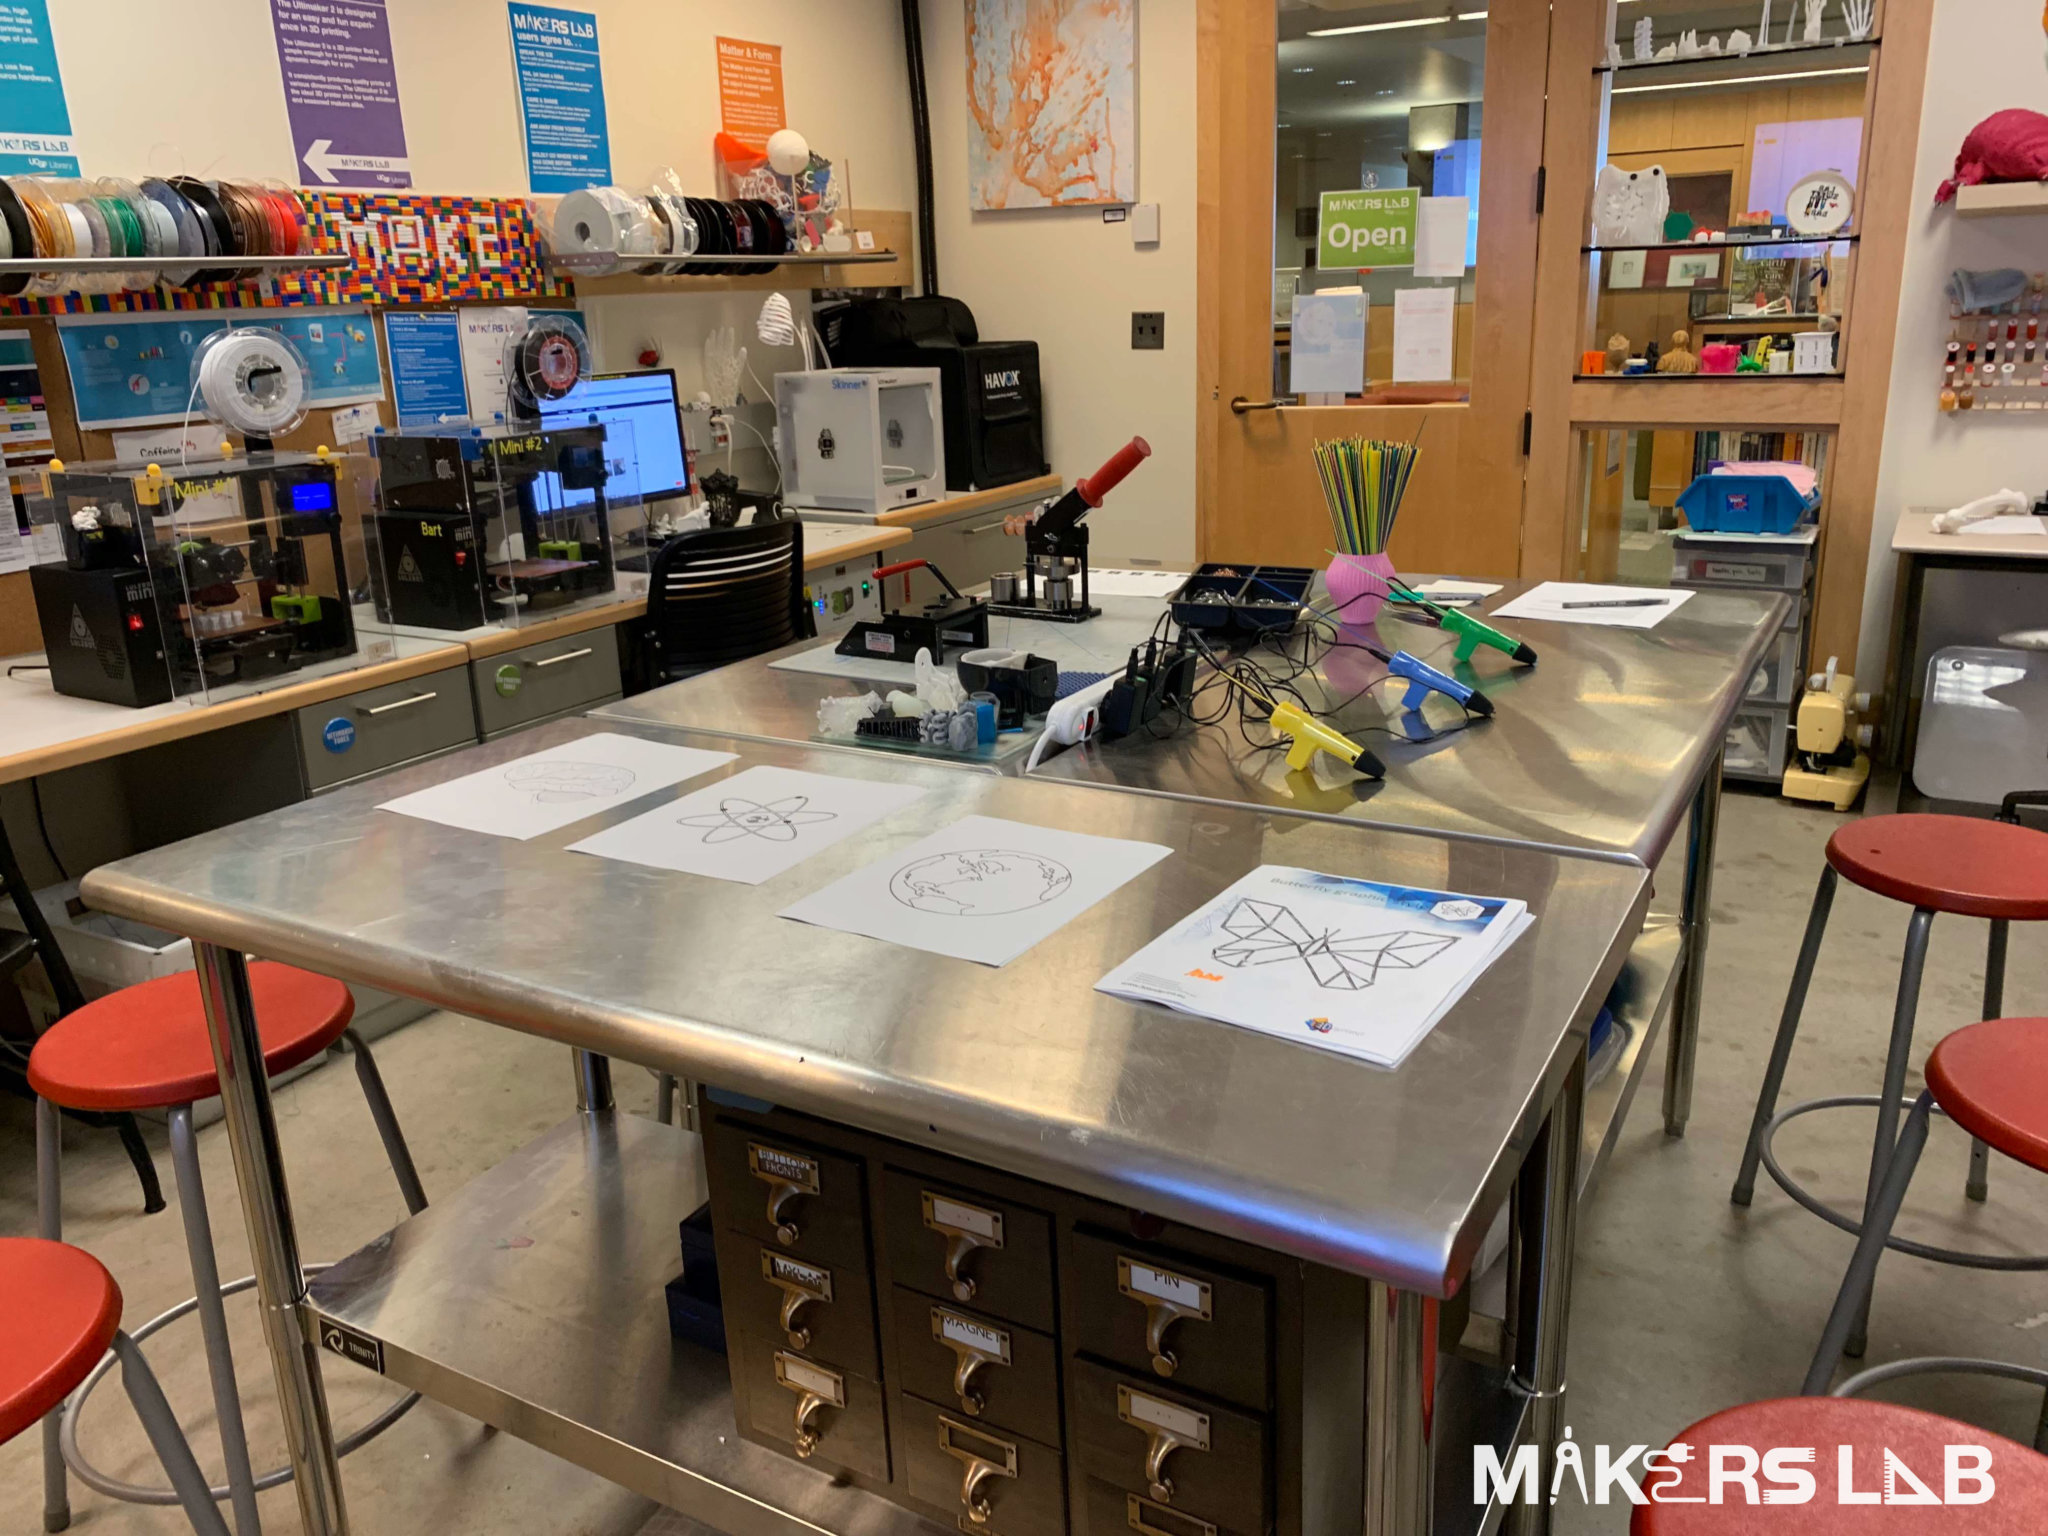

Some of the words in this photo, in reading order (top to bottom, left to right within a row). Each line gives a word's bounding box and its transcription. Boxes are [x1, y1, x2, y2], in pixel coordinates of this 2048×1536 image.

[513, 11, 570, 35] MAKERS
[570, 21, 594, 38] LAB
[516, 32, 539, 42] users
[540, 35, 562, 46] agree
[1329, 198, 1382, 212] MAKERS
[1384, 196, 1410, 210] LAB
[1328, 222, 1406, 253] Open
[832, 376, 862, 390] Skinner
[984, 370, 1020, 390] HAVOX
[500, 438, 524, 456] Mini
[526, 436, 542, 451] #2
[174, 480, 211, 500] Mini
[421, 521, 442, 538] Bart
[126, 587, 152, 602] min
[1270, 878, 1328, 893] Butterfly
[943, 1315, 1000, 1343] MAGNET
[349, 1342, 376, 1361] TRINITY
